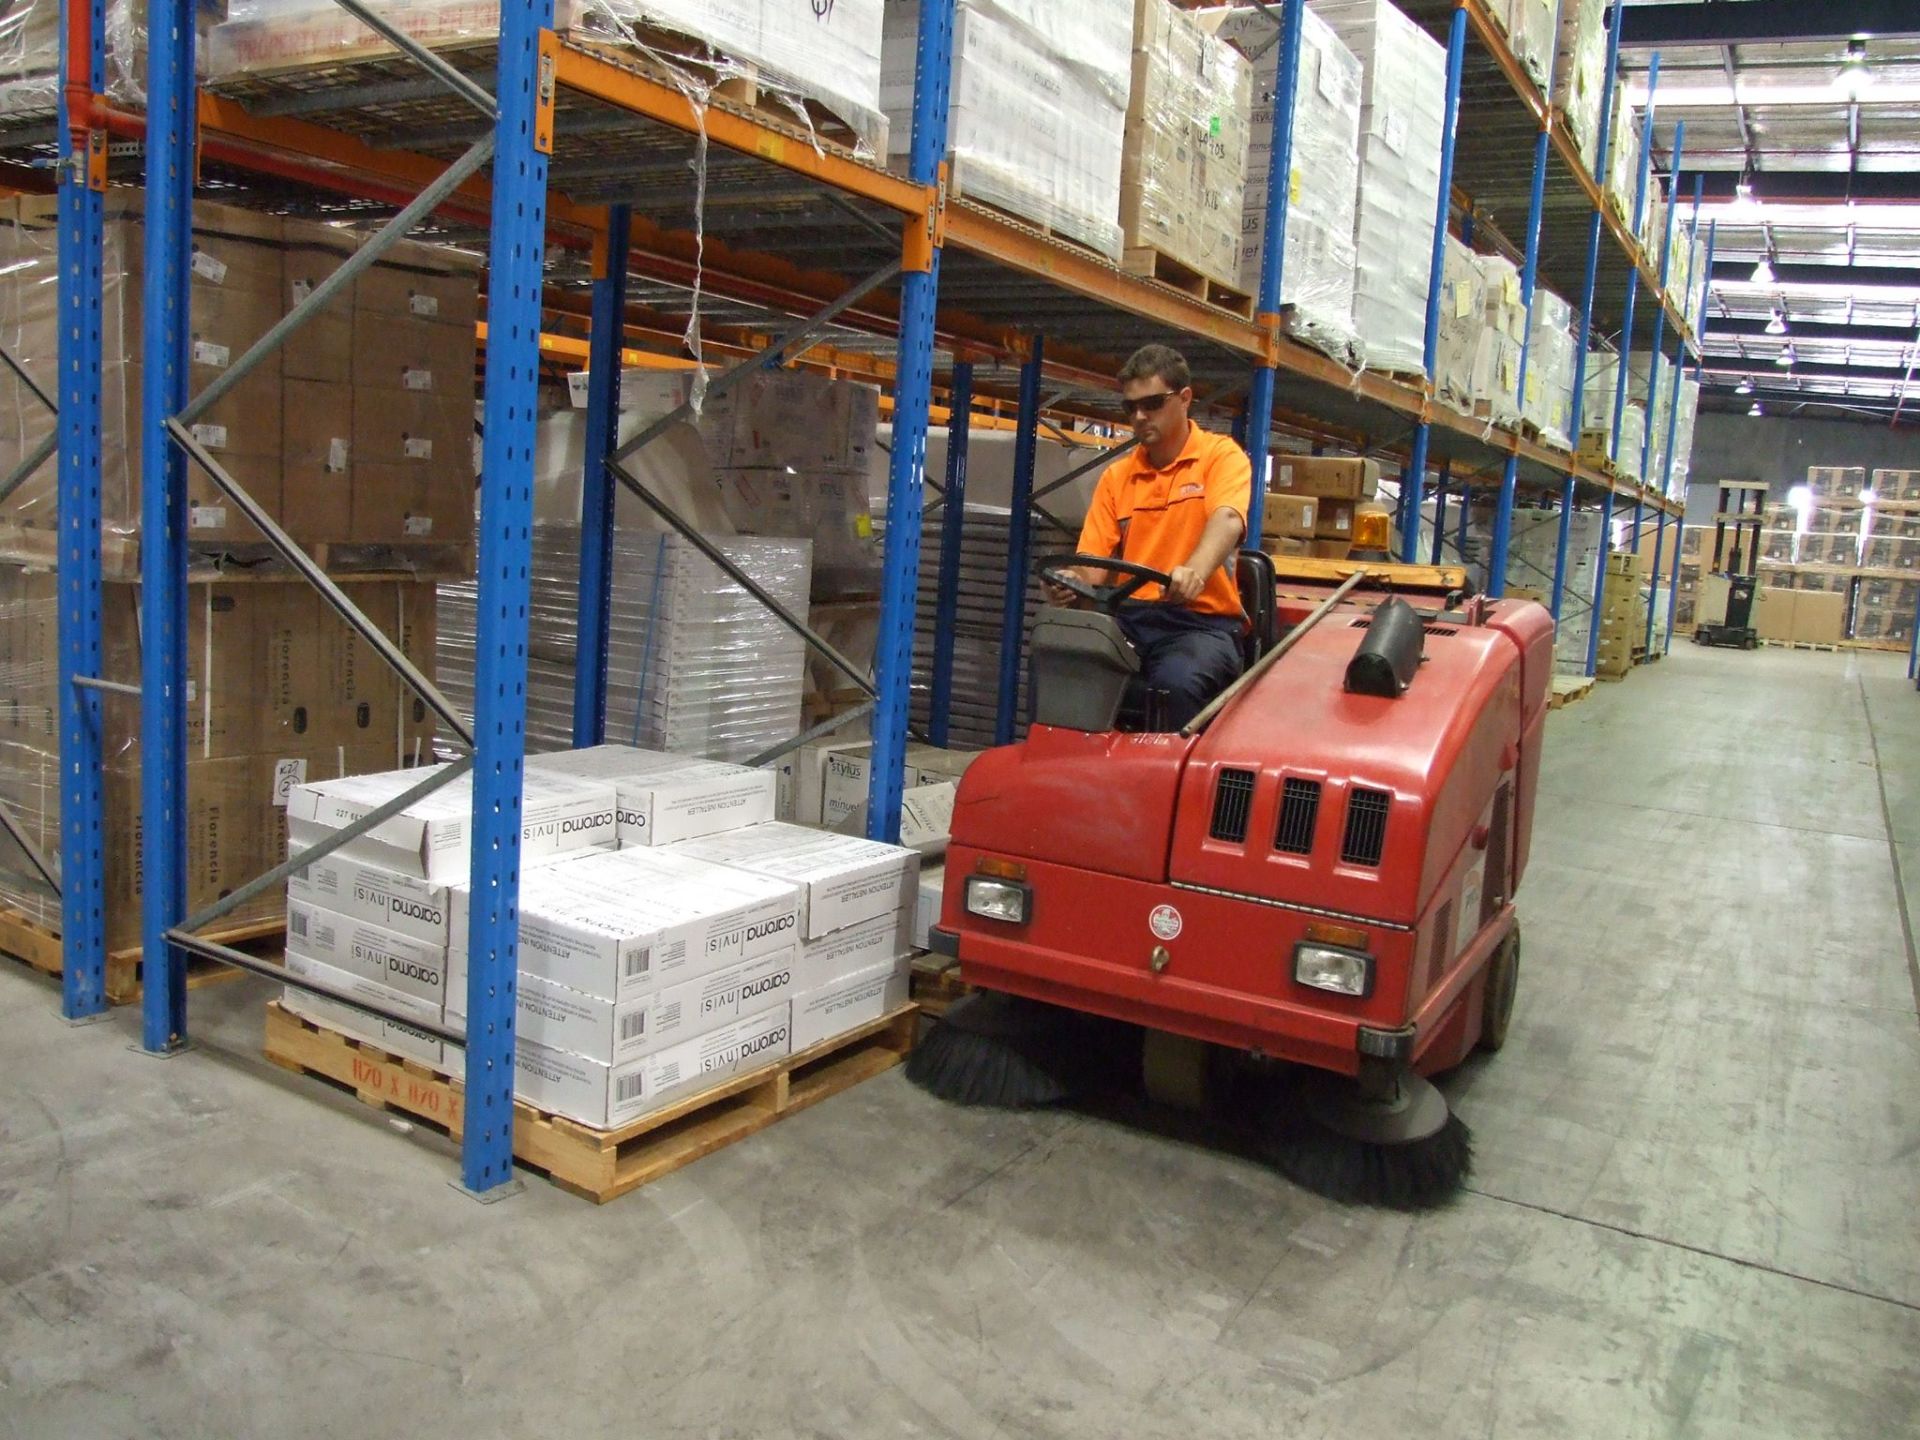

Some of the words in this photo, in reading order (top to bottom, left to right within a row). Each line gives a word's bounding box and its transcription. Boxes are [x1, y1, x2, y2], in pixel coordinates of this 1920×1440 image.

[282, 629, 292, 705] Florencia
[832, 762, 861, 776] stylus
[562, 811, 613, 834] caroma
[687, 802, 717, 816] INSTALLER
[209, 807, 220, 884] Florencia
[391, 899, 442, 926] caroma
[746, 914, 795, 942] caroma
[530, 937, 570, 959] ATTENTION
[388, 957, 439, 986] caroma
[742, 971, 791, 999] caroma
[525, 1001, 566, 1023] ATTENTION
[741, 1027, 787, 1058] caroma
[522, 1061, 562, 1083] ATTENTION
